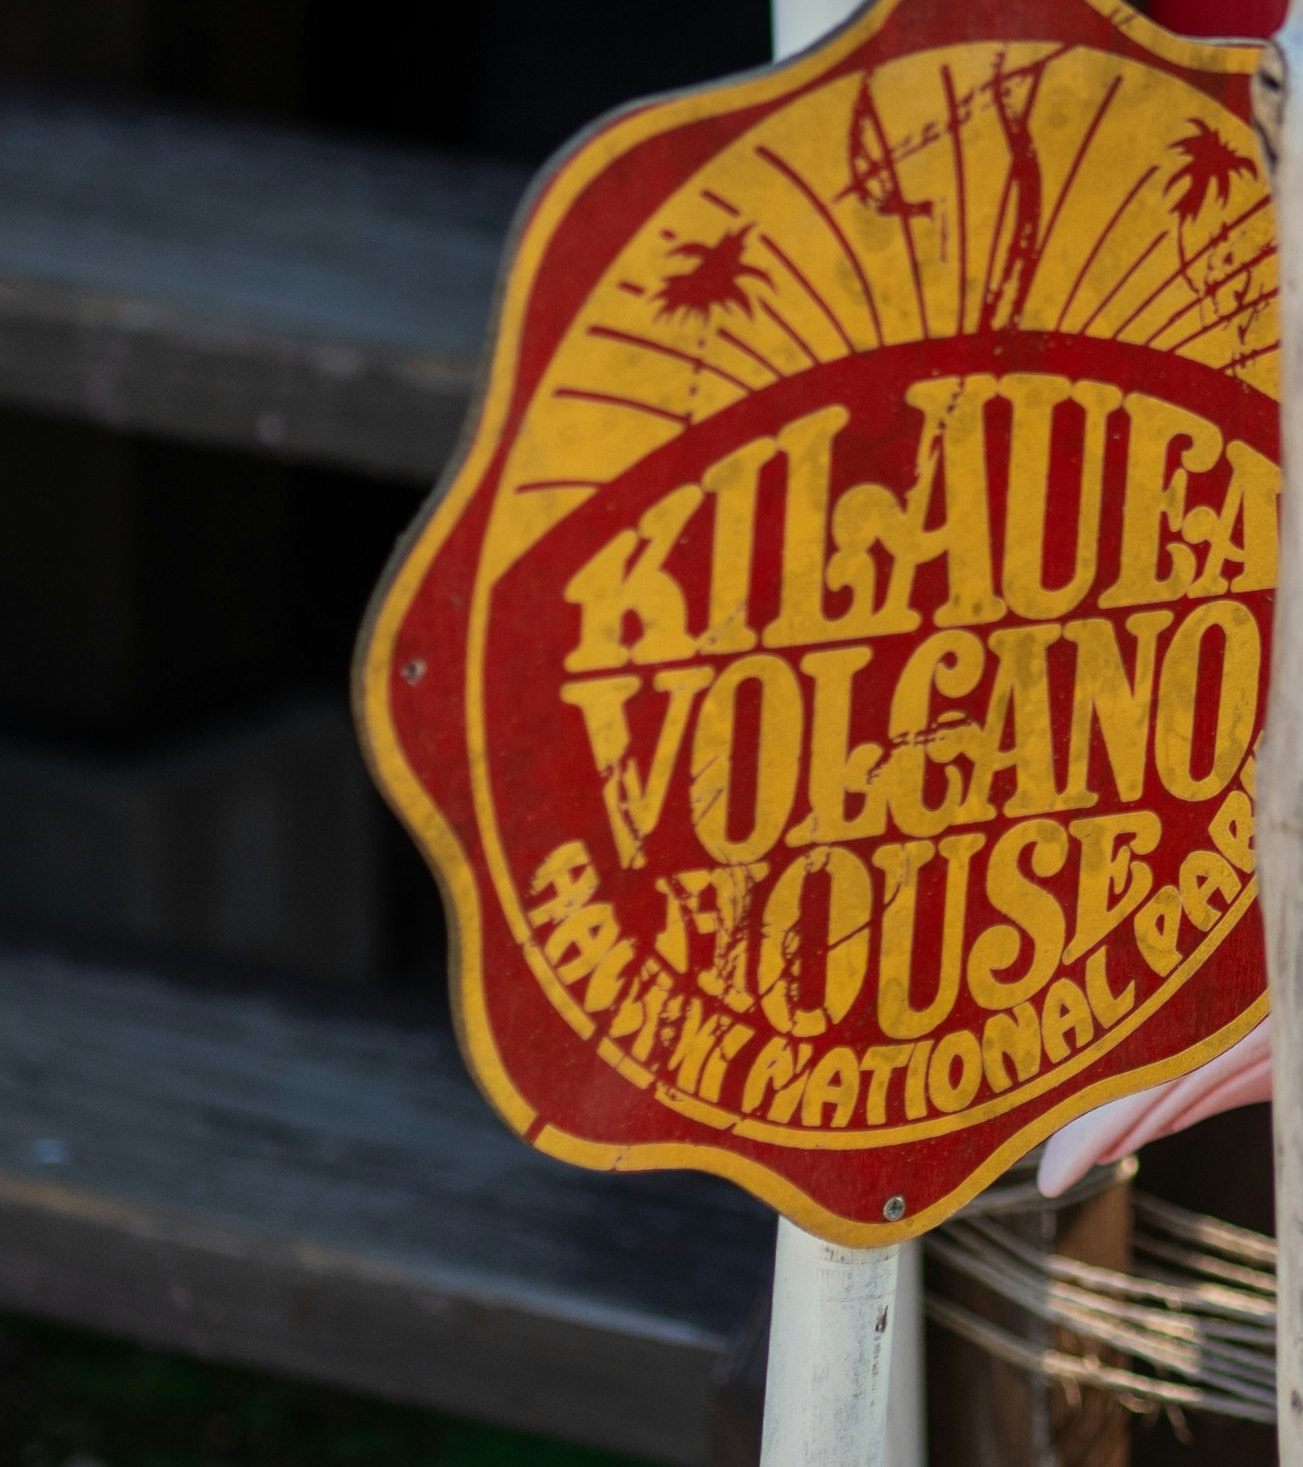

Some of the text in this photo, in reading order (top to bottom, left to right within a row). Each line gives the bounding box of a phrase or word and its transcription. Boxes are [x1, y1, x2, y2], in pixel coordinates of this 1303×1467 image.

[561, 373, 1283, 673] KILAUEA
[563, 598, 1264, 870] VOLCANO
[655, 809, 1163, 1042] HOUSE
[741, 944, 1136, 1126] NATIONAL
[1134, 730, 1262, 978] PAR
